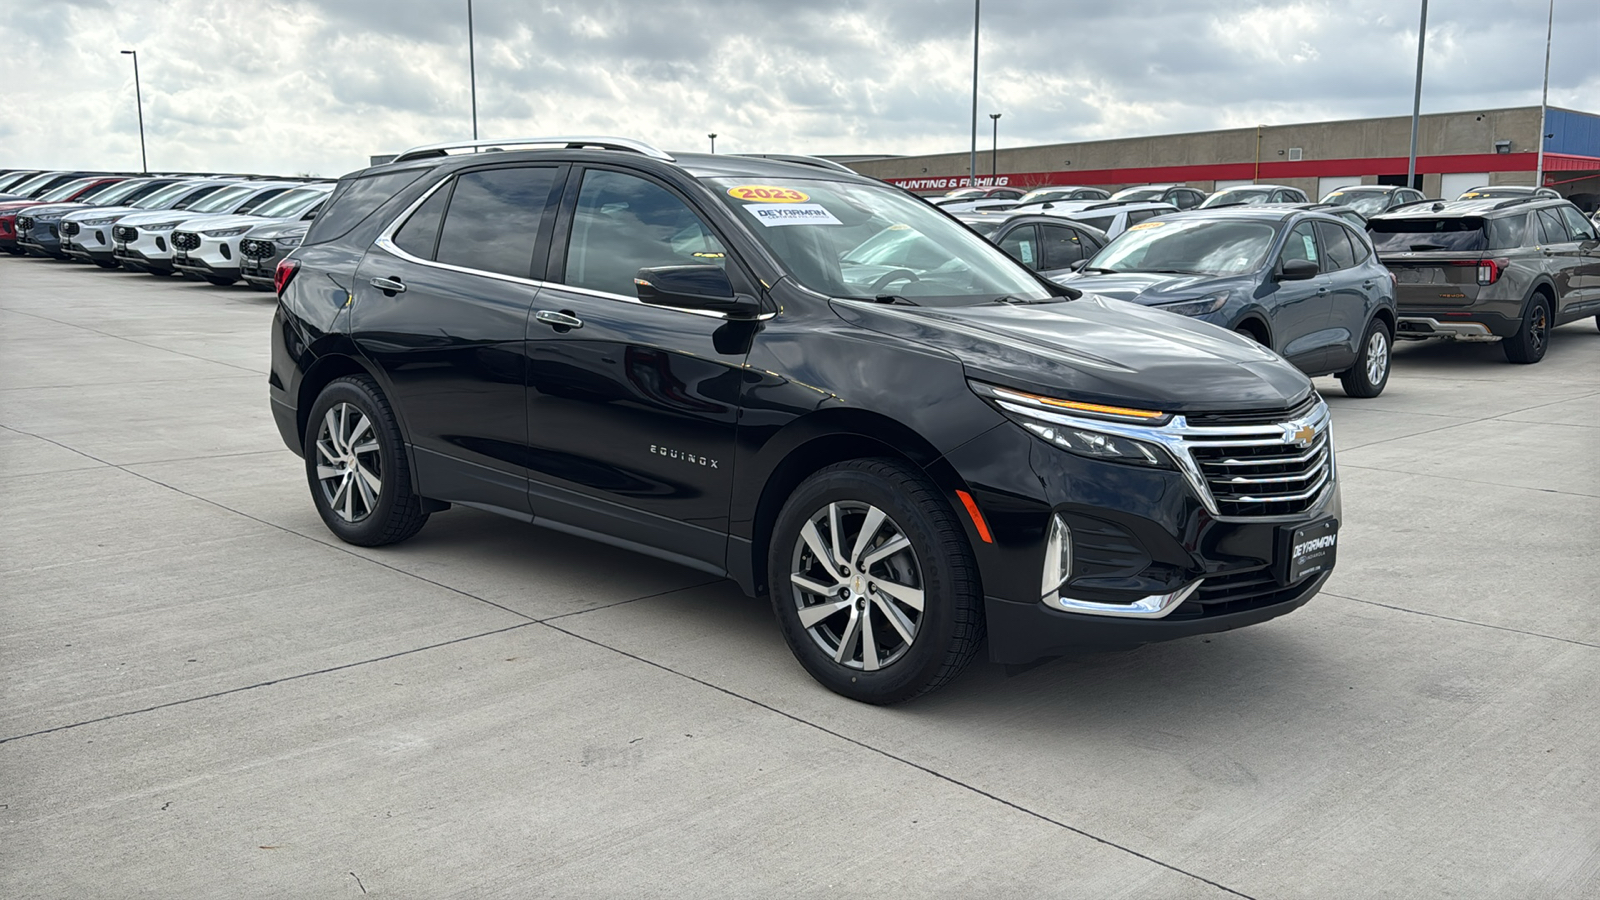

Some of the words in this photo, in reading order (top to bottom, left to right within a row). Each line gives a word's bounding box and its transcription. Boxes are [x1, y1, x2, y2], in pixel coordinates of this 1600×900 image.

[895, 179, 947, 189] HUNTING
[948, 178, 957, 188] &
[959, 176, 1009, 187] FISHING
[738, 188, 804, 200] 2023
[757, 209, 827, 217] DEYARMAN
[650, 444, 718, 469] EQUINOX
[1292, 534, 1336, 559] DEYARMAN
